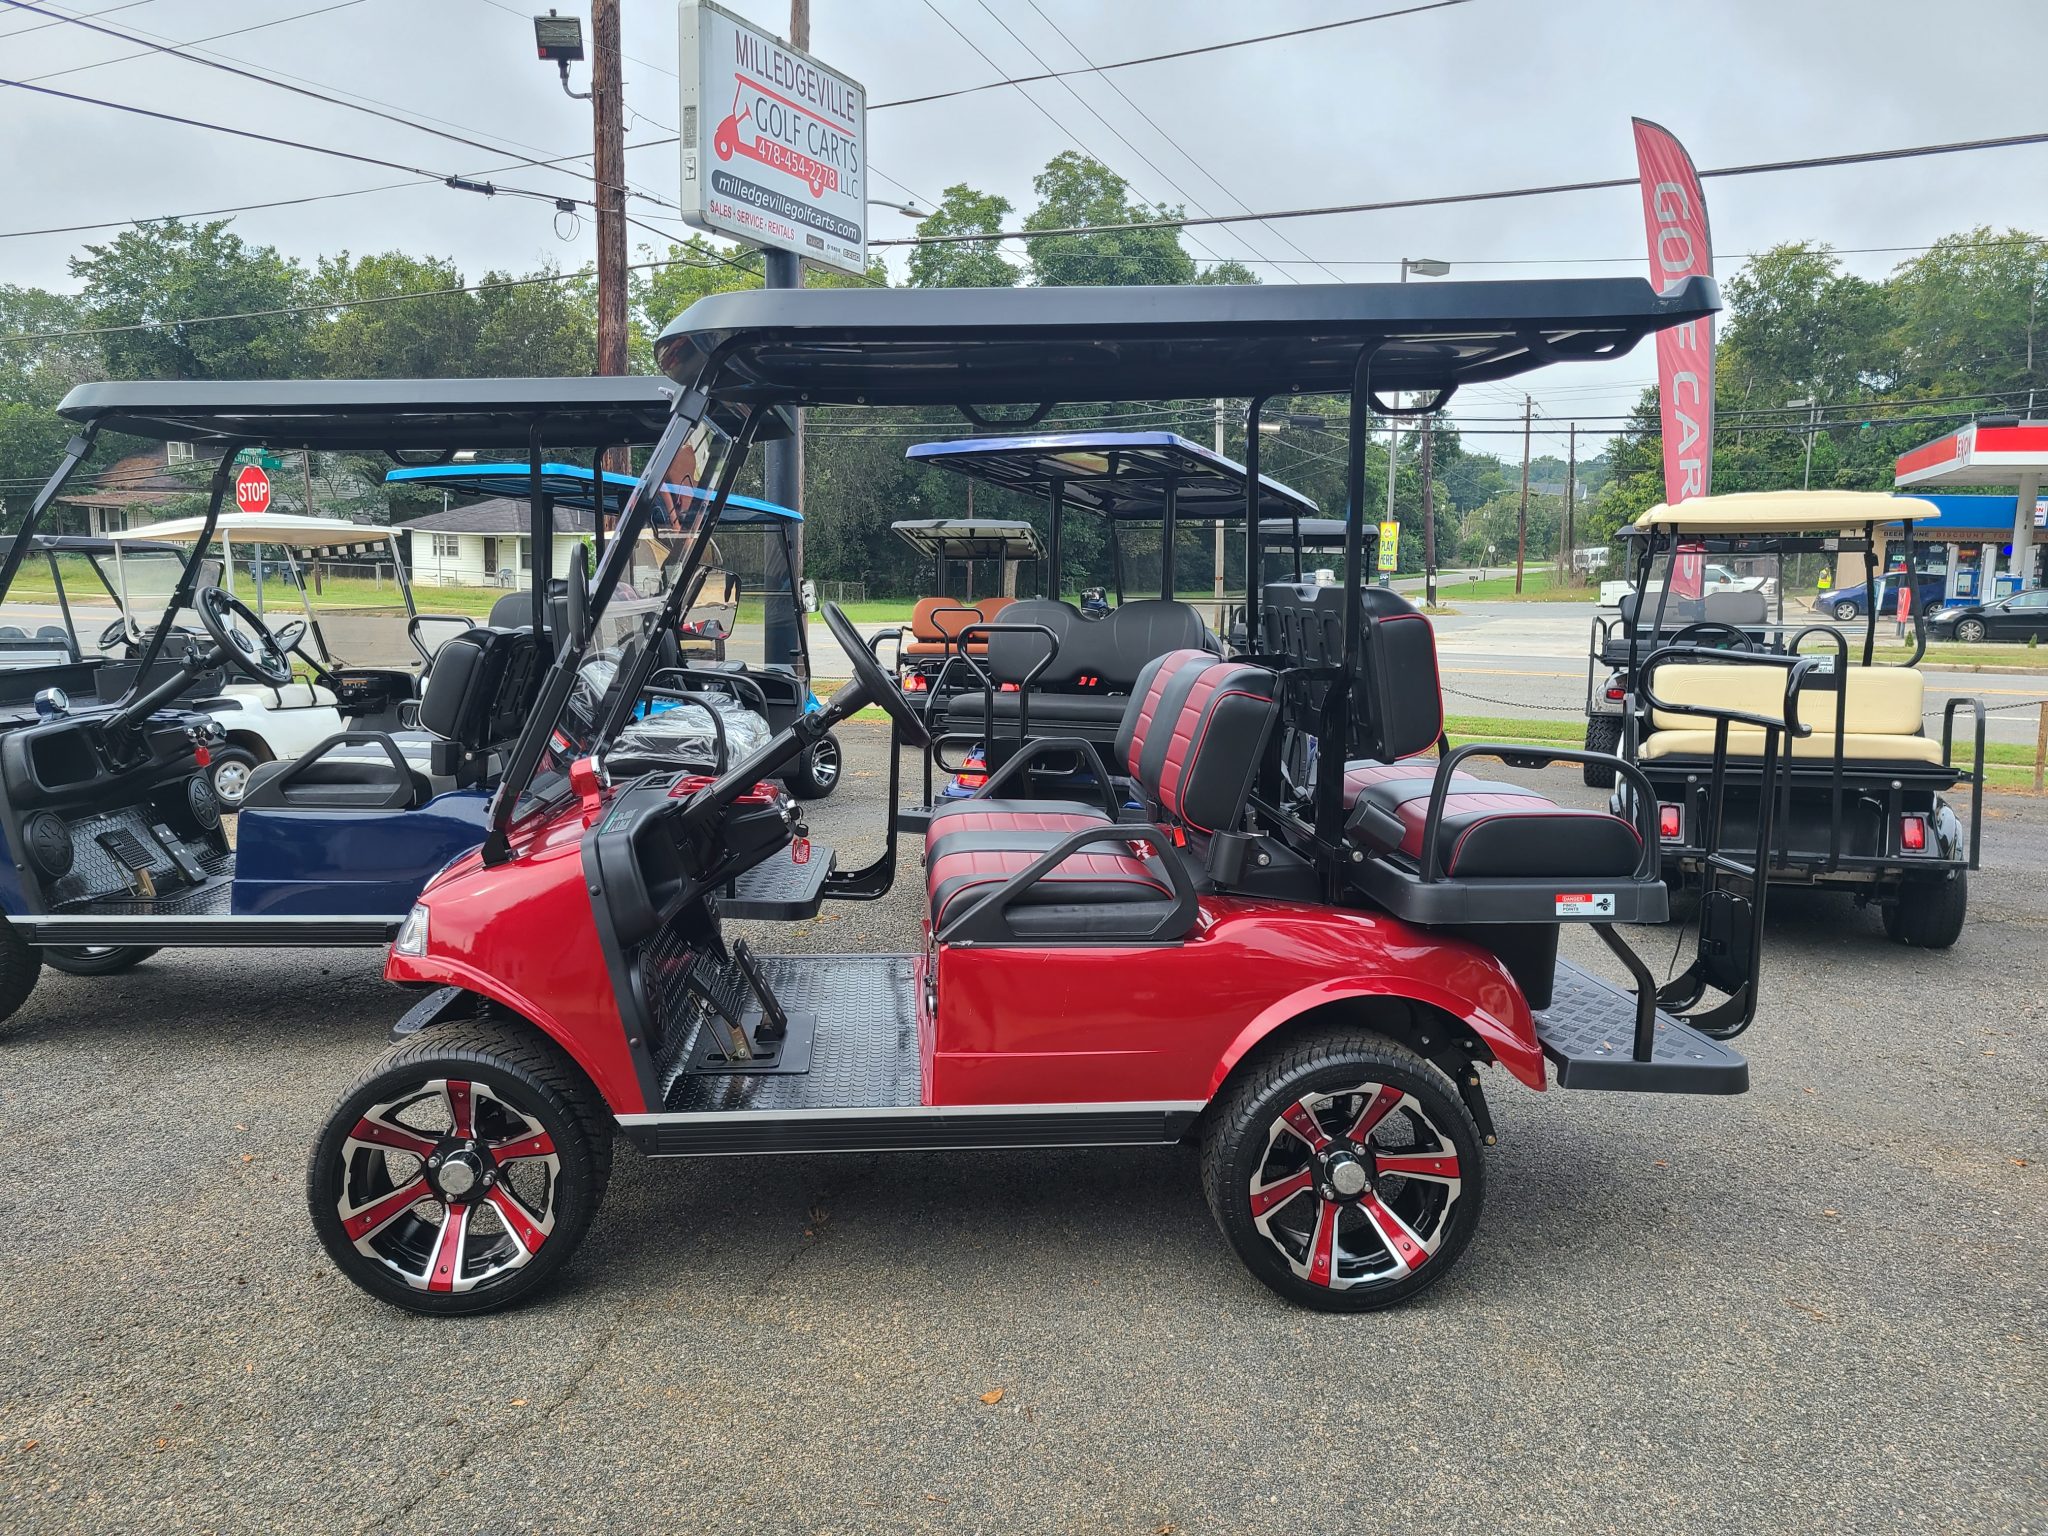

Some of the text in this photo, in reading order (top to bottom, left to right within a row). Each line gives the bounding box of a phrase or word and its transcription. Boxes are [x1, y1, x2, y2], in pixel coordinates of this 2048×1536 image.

[735, 30, 855, 123] MILLEDGEVILLE
[755, 97, 802, 146] GOLF
[807, 122, 858, 174] CARTS
[758, 139, 836, 188] 478-454-2278
[718, 177, 857, 240] milledgevillegolfcarts.com
[840, 173, 858, 200] LLC
[709, 200, 795, 241] SALES SERVICE RENTALS
[1654, 182, 1697, 352] GOF
[239, 482, 268, 503] STOP
[1380, 553, 1394, 566] HERE
[1381, 540, 1395, 552] PLAY
